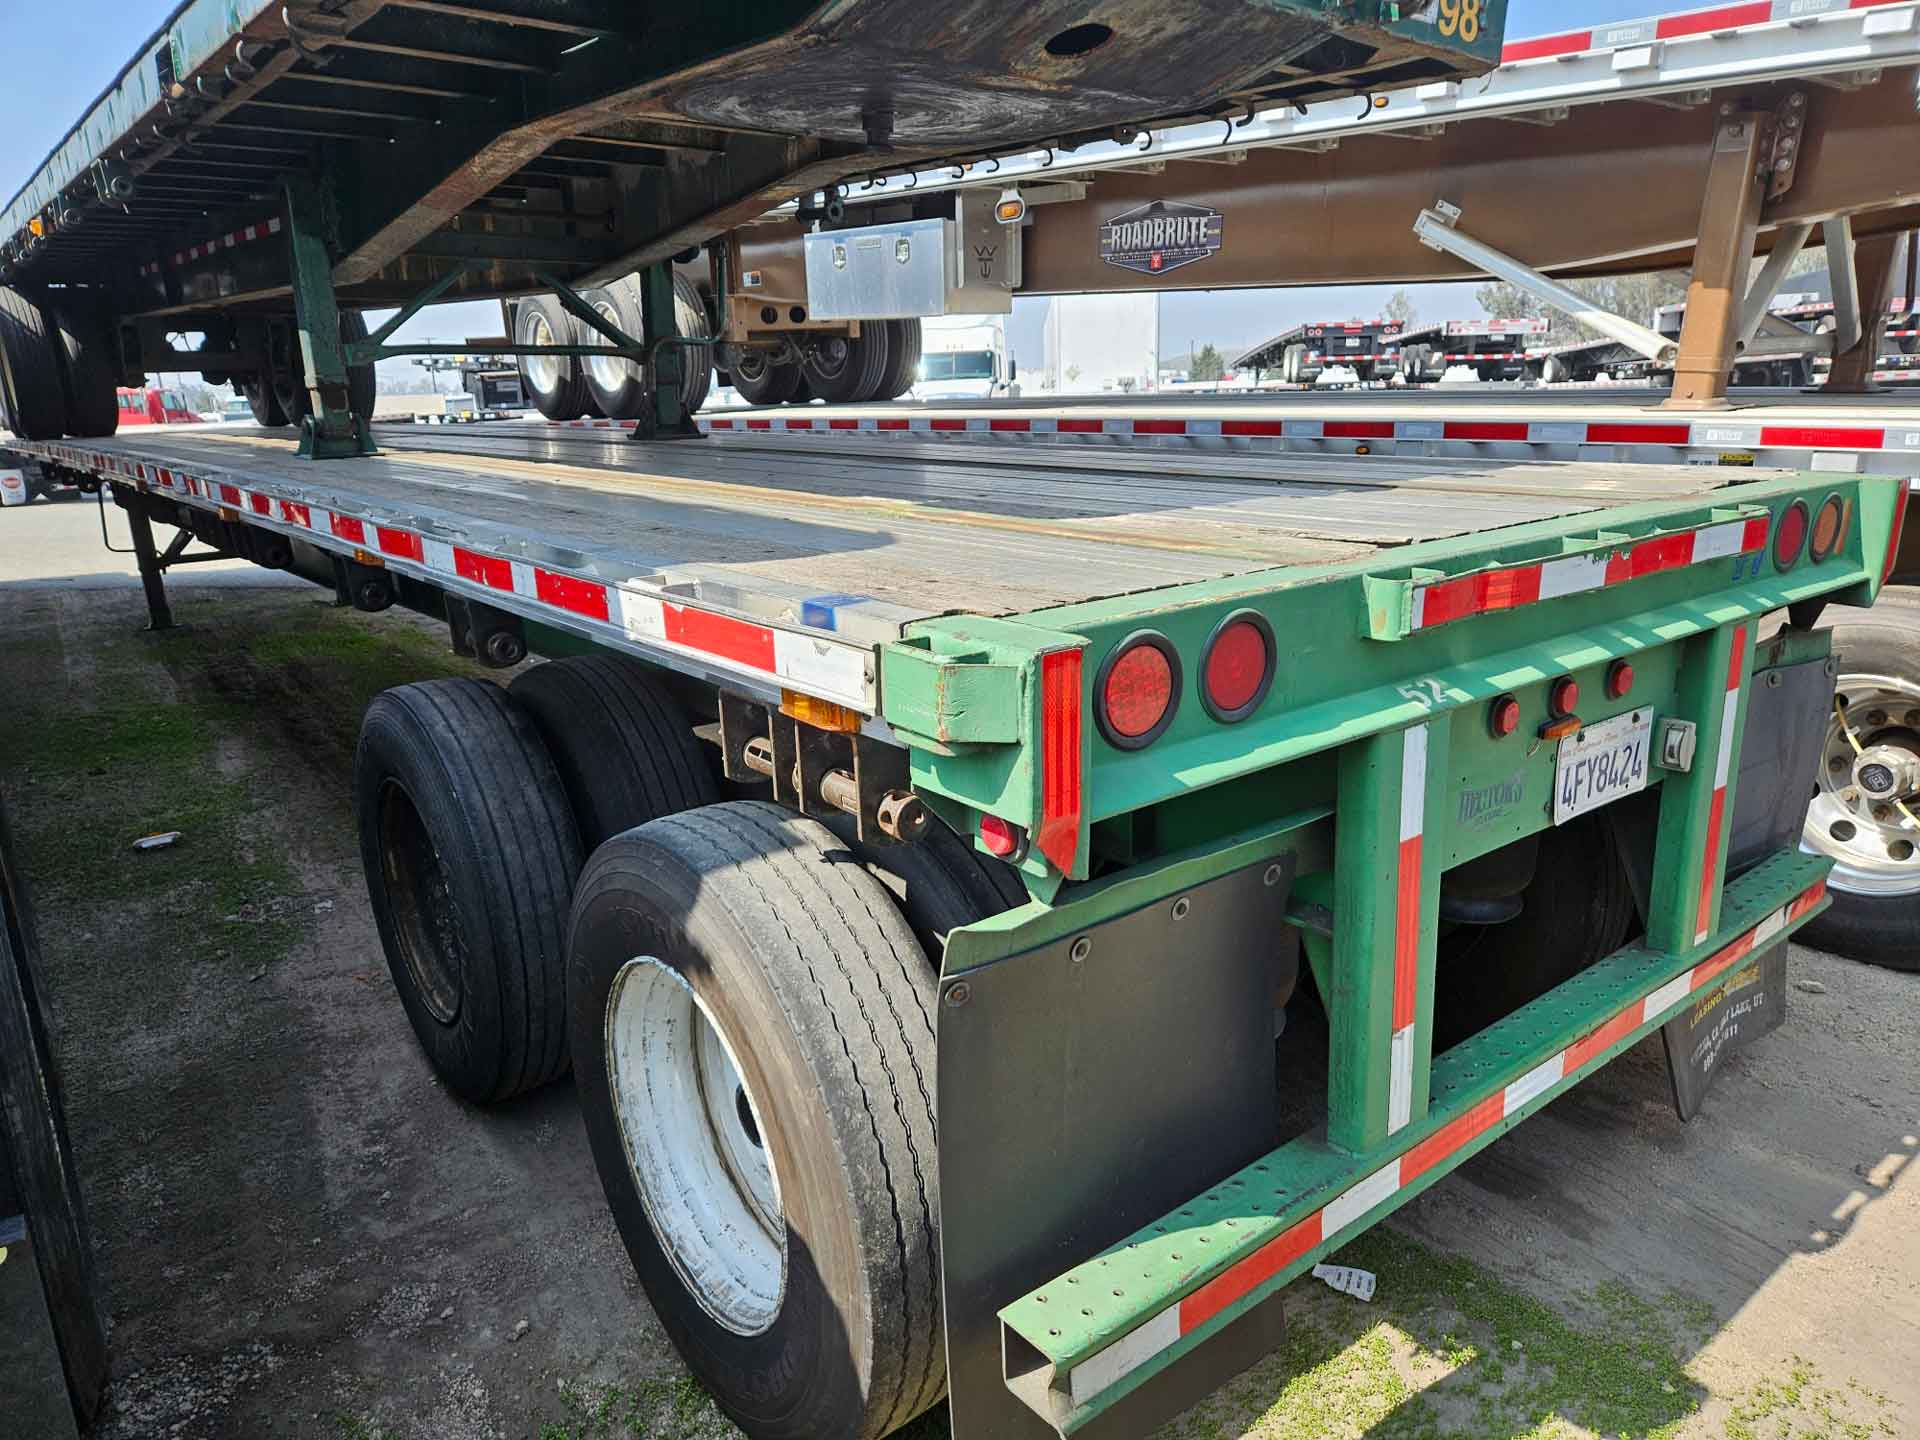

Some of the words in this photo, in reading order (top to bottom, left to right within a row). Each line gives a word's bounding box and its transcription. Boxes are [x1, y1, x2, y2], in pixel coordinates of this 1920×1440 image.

[1438, 0, 1481, 42] 98
[1110, 216, 1208, 251] ROADBRUTE
[1396, 678, 1447, 713] 52
[1561, 740, 1643, 807] 4FY8424
